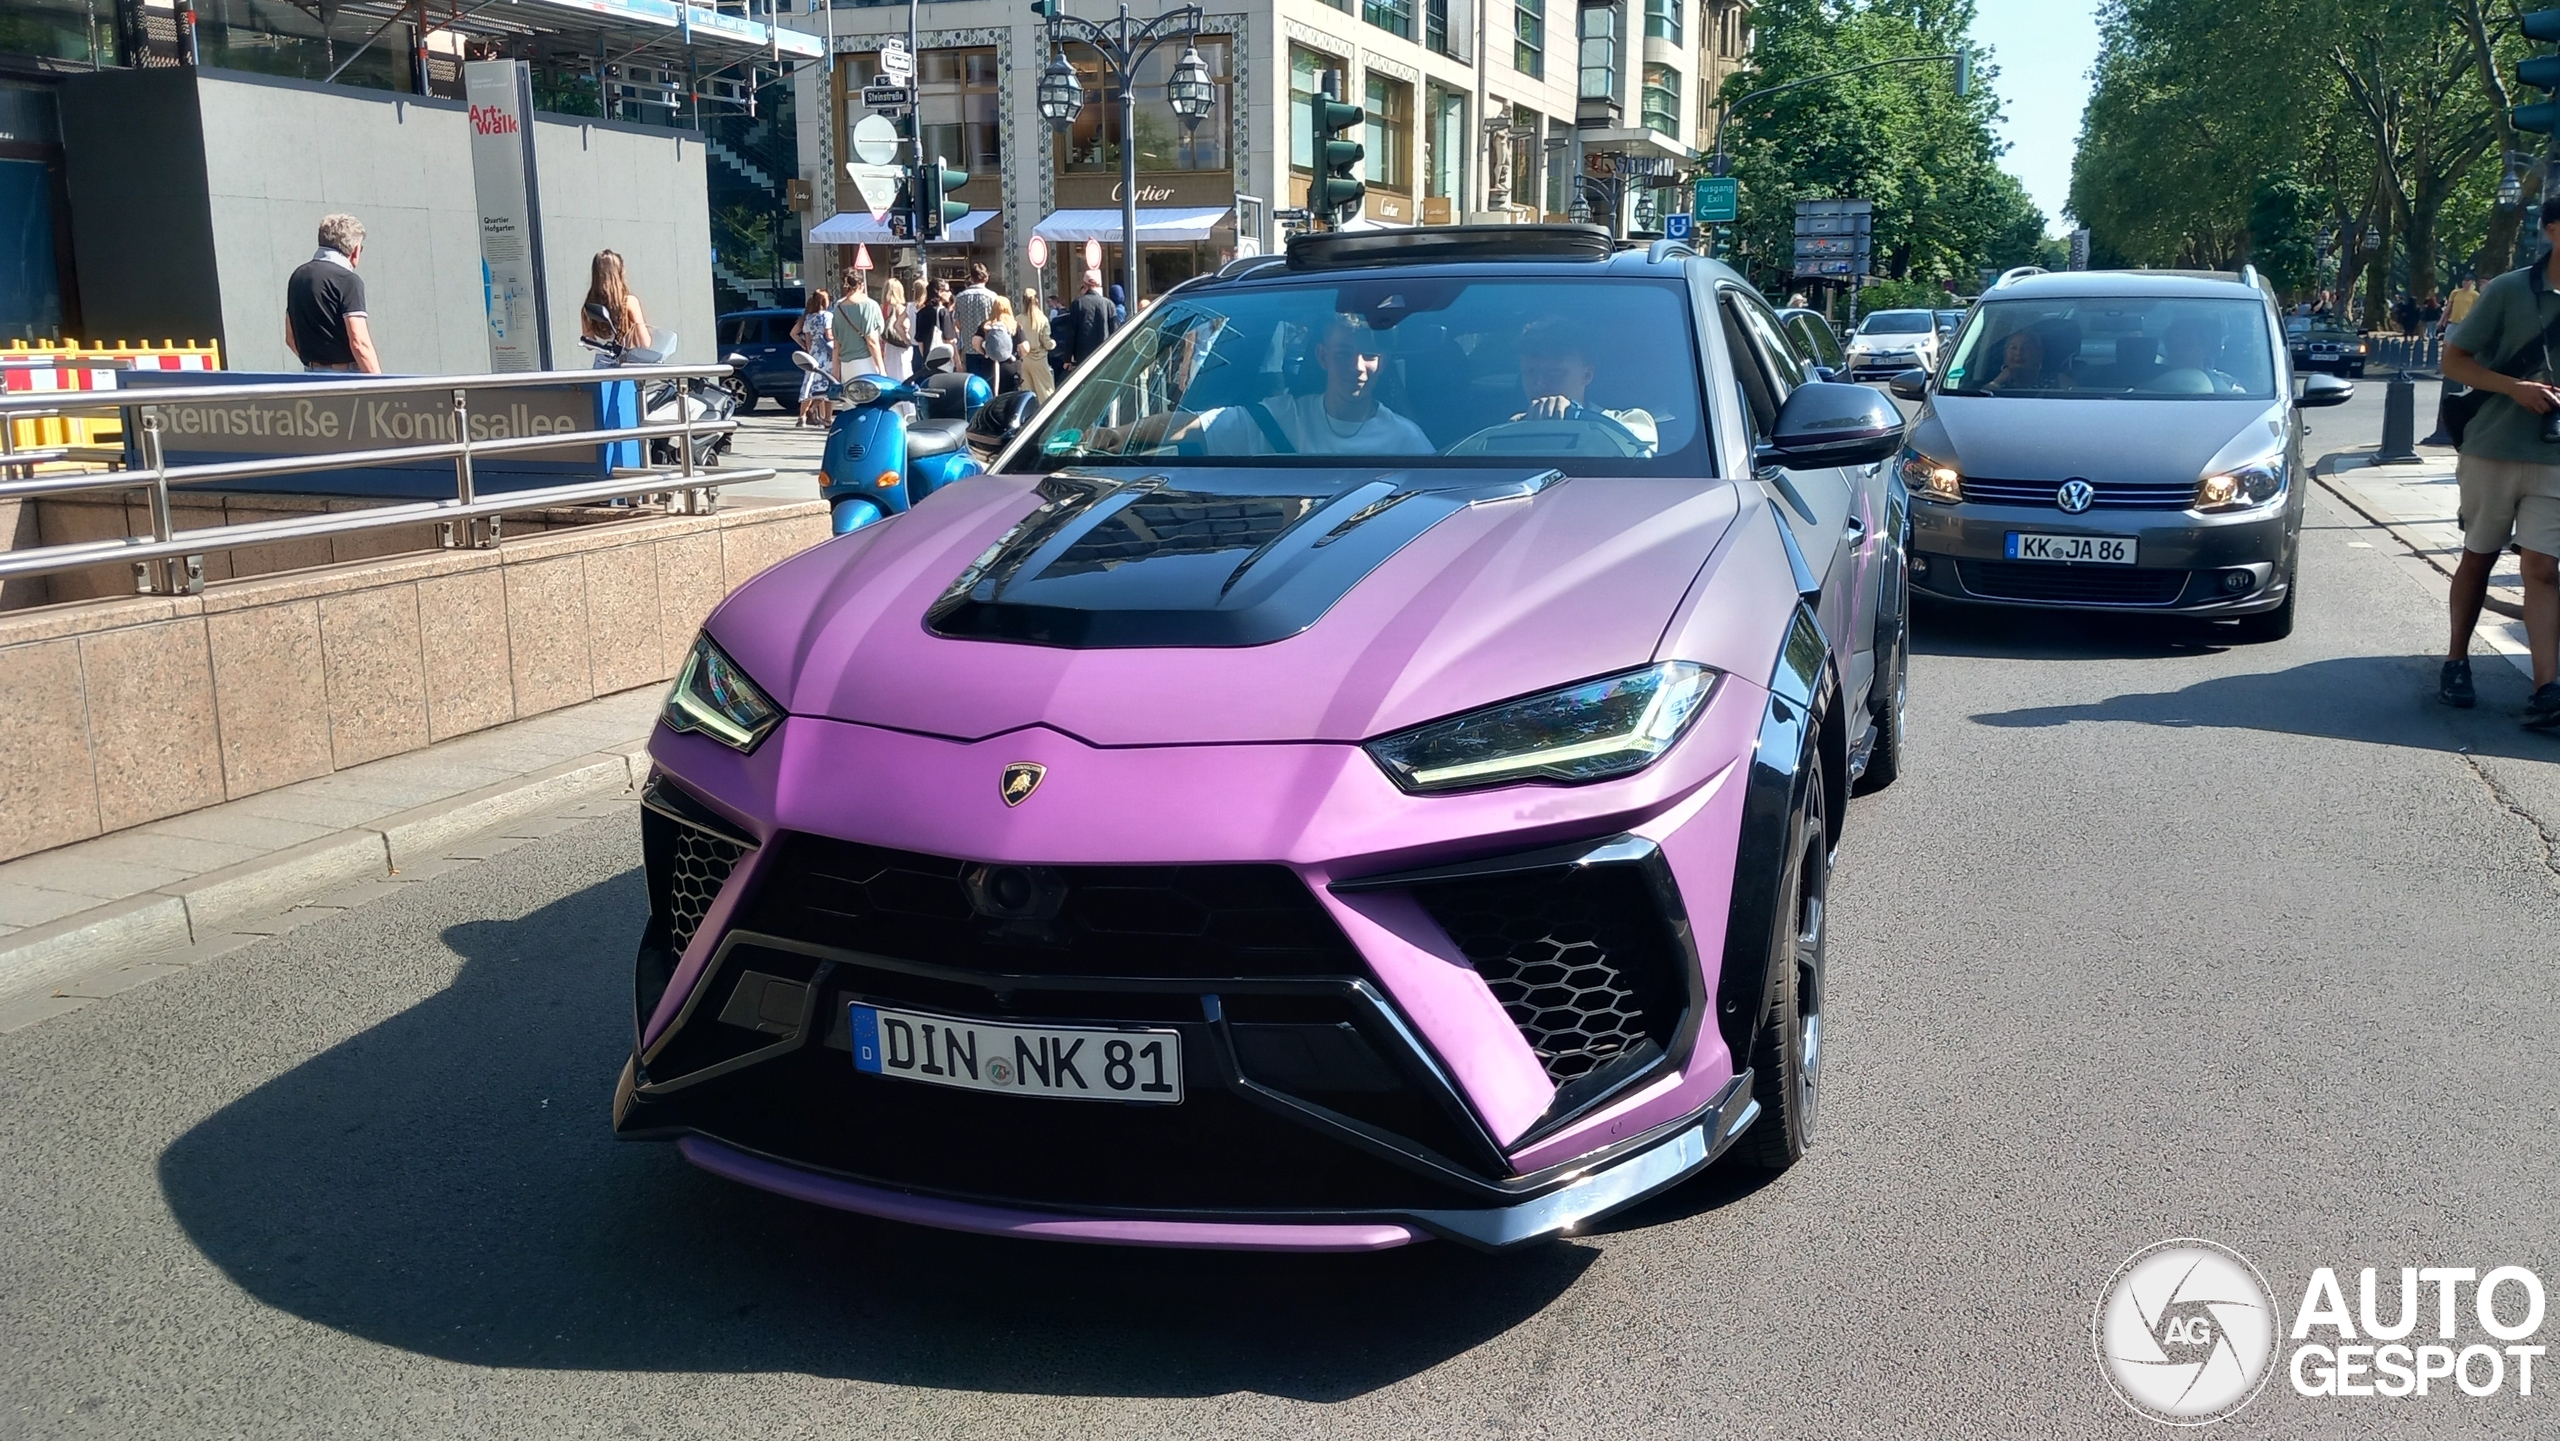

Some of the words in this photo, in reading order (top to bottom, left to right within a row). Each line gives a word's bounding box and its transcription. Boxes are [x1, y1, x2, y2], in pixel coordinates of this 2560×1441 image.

[867, 91, 904, 102] Steinstraße
[476, 114, 518, 136] walk
[1615, 156, 1675, 177] SATURN
[1111, 181, 1175, 202] Crtier
[1698, 185, 1734, 194] Ausgang
[1707, 195, 1723, 203] Exit
[1380, 198, 1400, 217] Cartier
[484, 225, 515, 233] Hofgarten
[2023, 537, 2052, 558] KK
[2065, 540, 2093, 559] JA
[2098, 541, 2125, 561] 86
[883, 1018, 979, 1081] DIN
[1014, 1035, 1089, 1090] NK
[1103, 1039, 1174, 1093] 81
